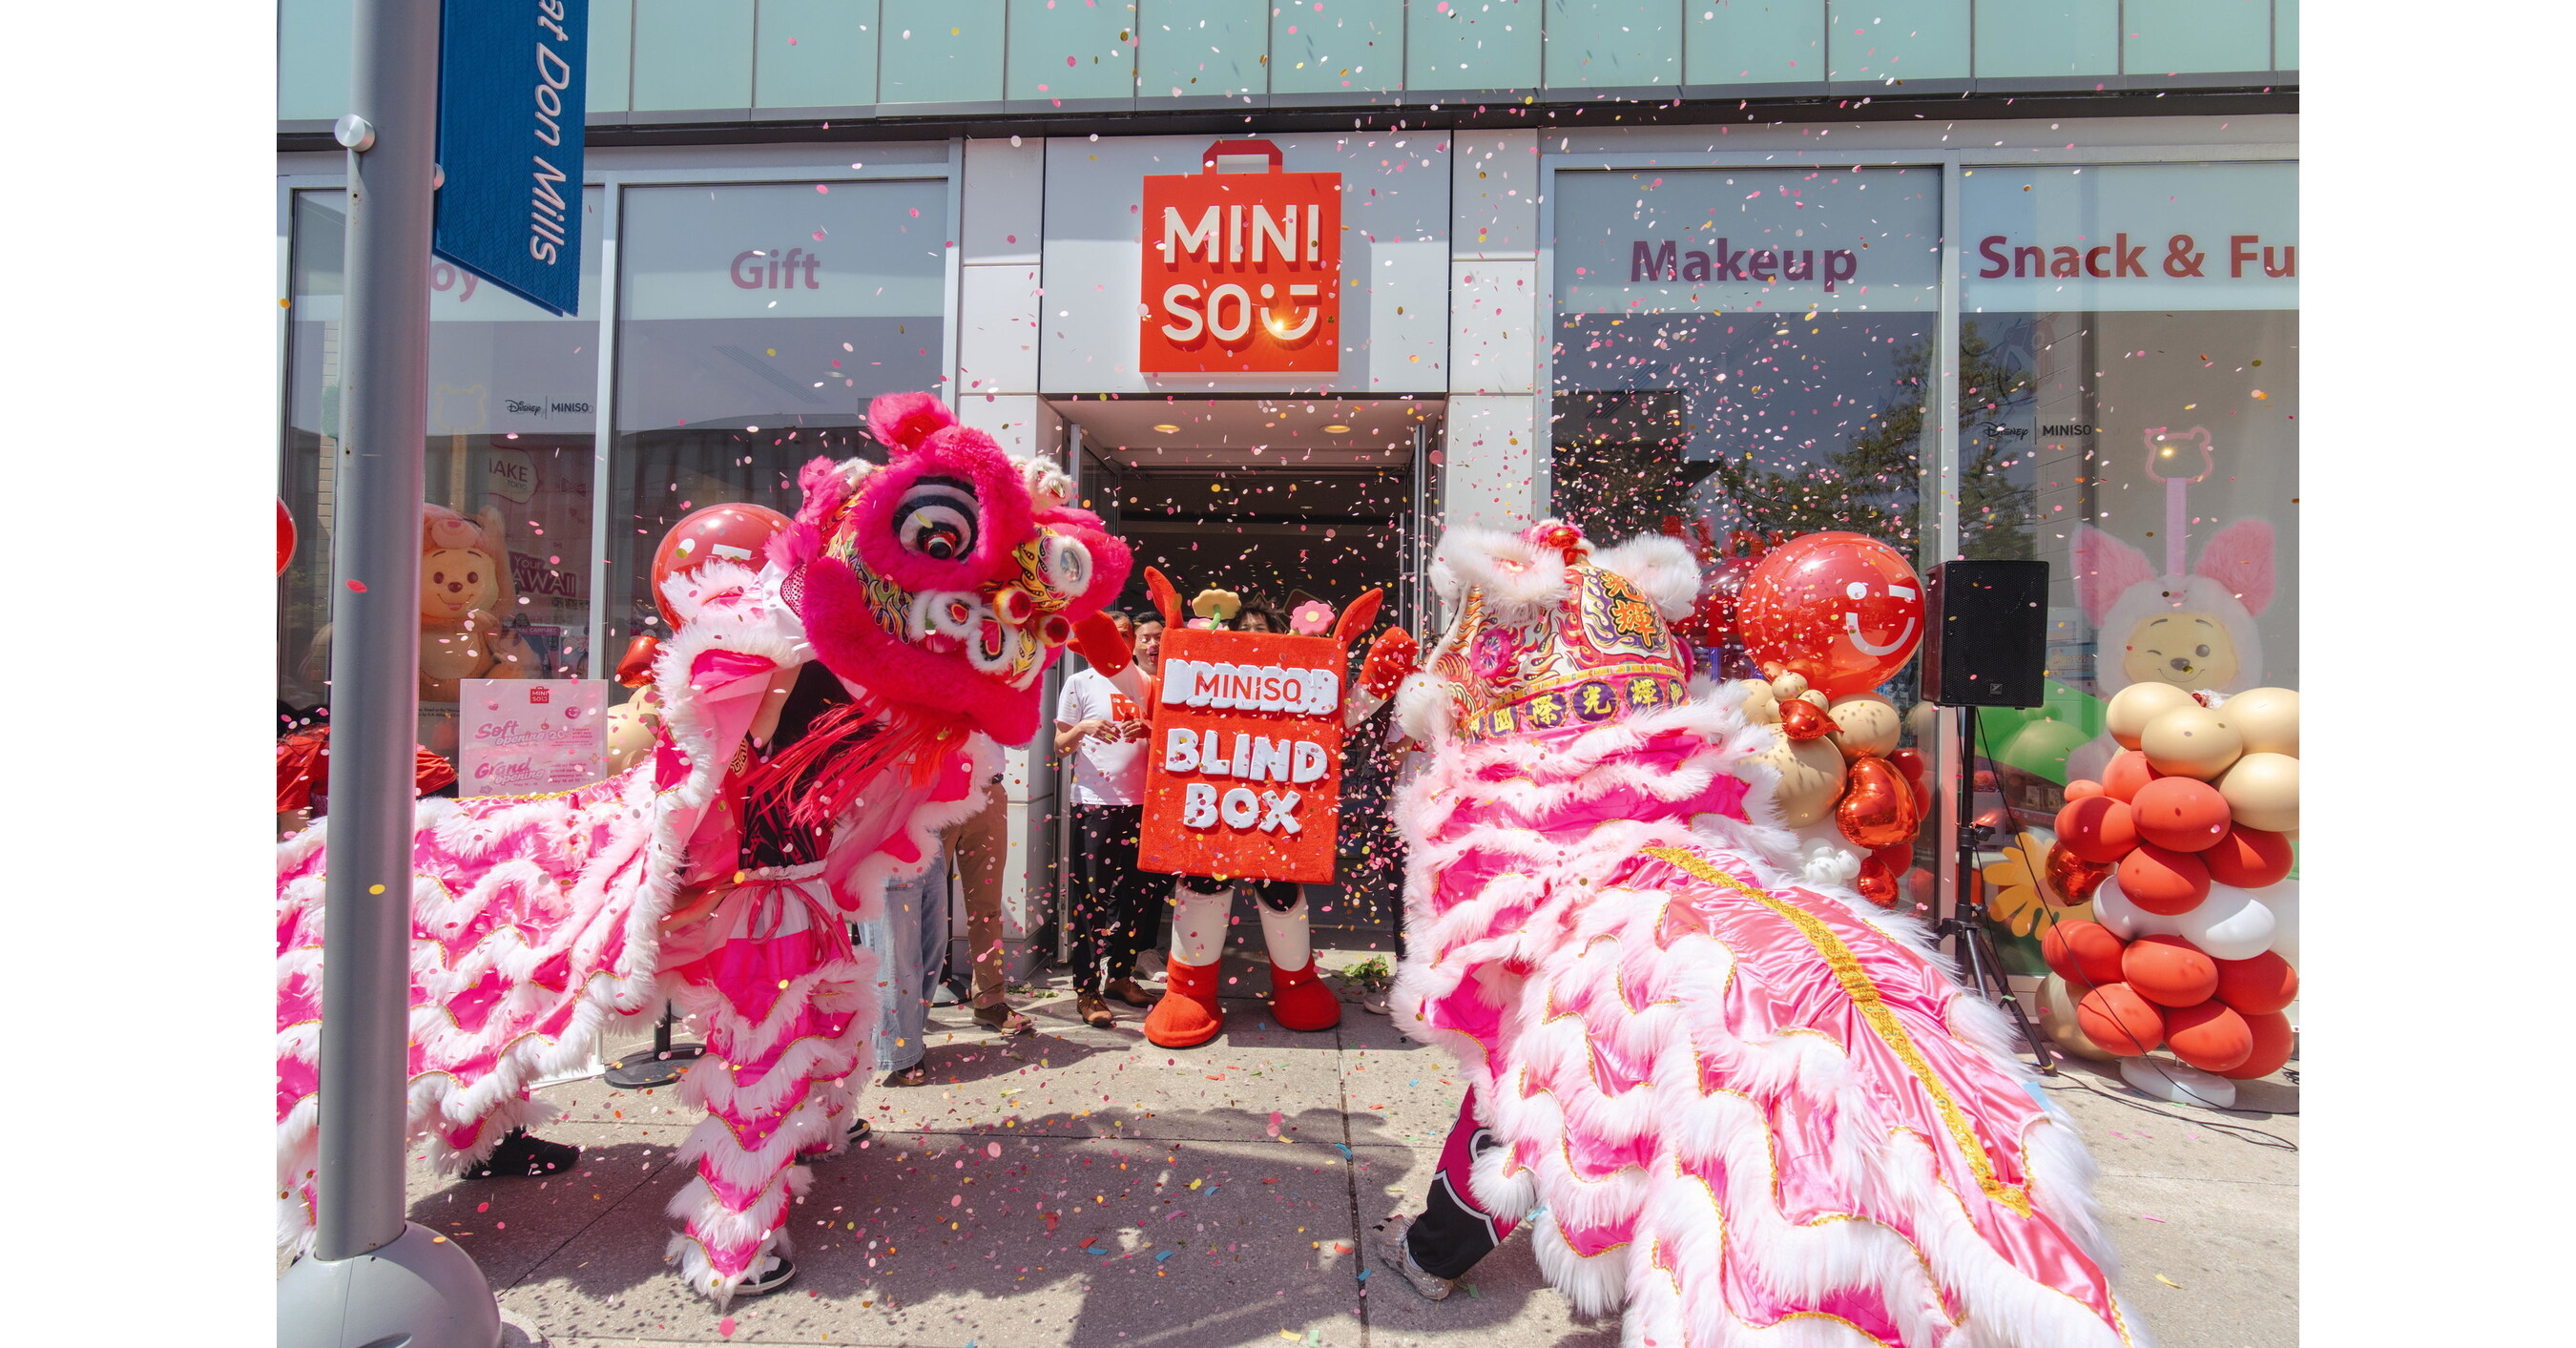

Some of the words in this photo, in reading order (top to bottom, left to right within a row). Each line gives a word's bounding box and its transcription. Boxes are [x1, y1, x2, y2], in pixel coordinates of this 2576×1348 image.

[535, 42, 570, 146] Don
[530, 156, 567, 265] Mills
[1164, 204, 1319, 263] MINI
[730, 248, 821, 290] Gift
[1631, 238, 1858, 292] Makeup
[1979, 233, 2149, 279] Snack
[2163, 234, 2205, 278] &
[2231, 235, 2296, 278] Fu
[551, 403, 589, 413] MINISO
[2042, 425, 2092, 436] MINISO
[515, 557, 541, 570] Your
[1195, 673, 1301, 702] MINISO
[475, 720, 519, 740] Soft
[496, 731, 546, 746] opening
[474, 757, 532, 778] Grand
[1165, 728, 1327, 783] BLIND
[494, 769, 545, 786] opening
[1183, 783, 1300, 834] BOX
